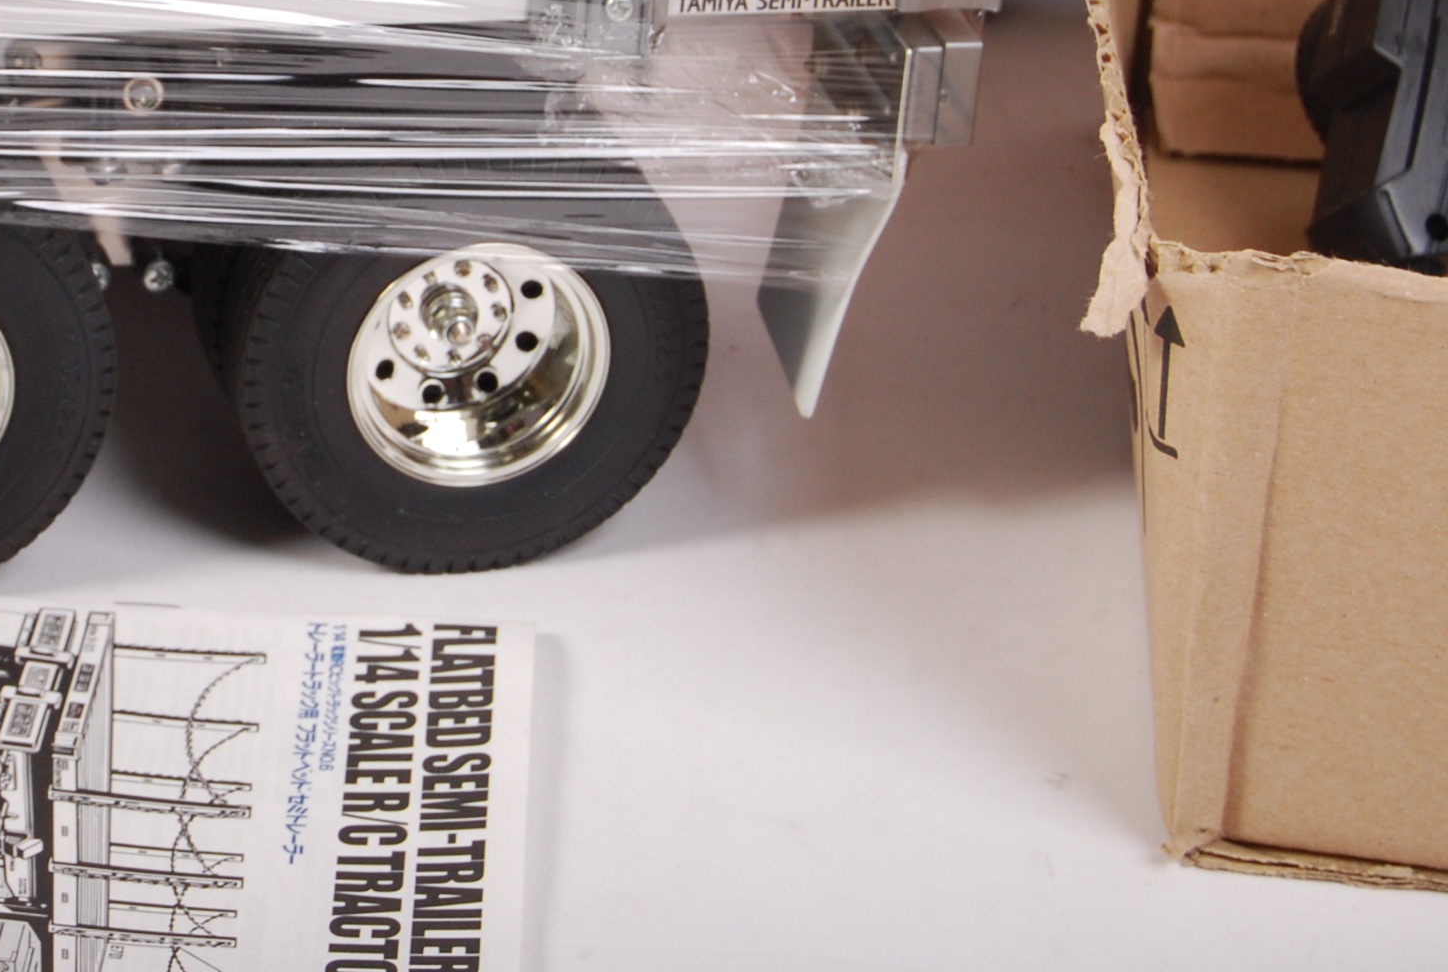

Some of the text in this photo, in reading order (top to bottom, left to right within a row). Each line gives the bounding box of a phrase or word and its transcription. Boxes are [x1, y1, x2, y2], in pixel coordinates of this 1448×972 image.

[354, 623, 422, 684] 1/14
[345, 690, 419, 784] SCALE
[338, 791, 411, 846] R/C
[408, 624, 497, 972] FLATBED SEMI-TRAILER
